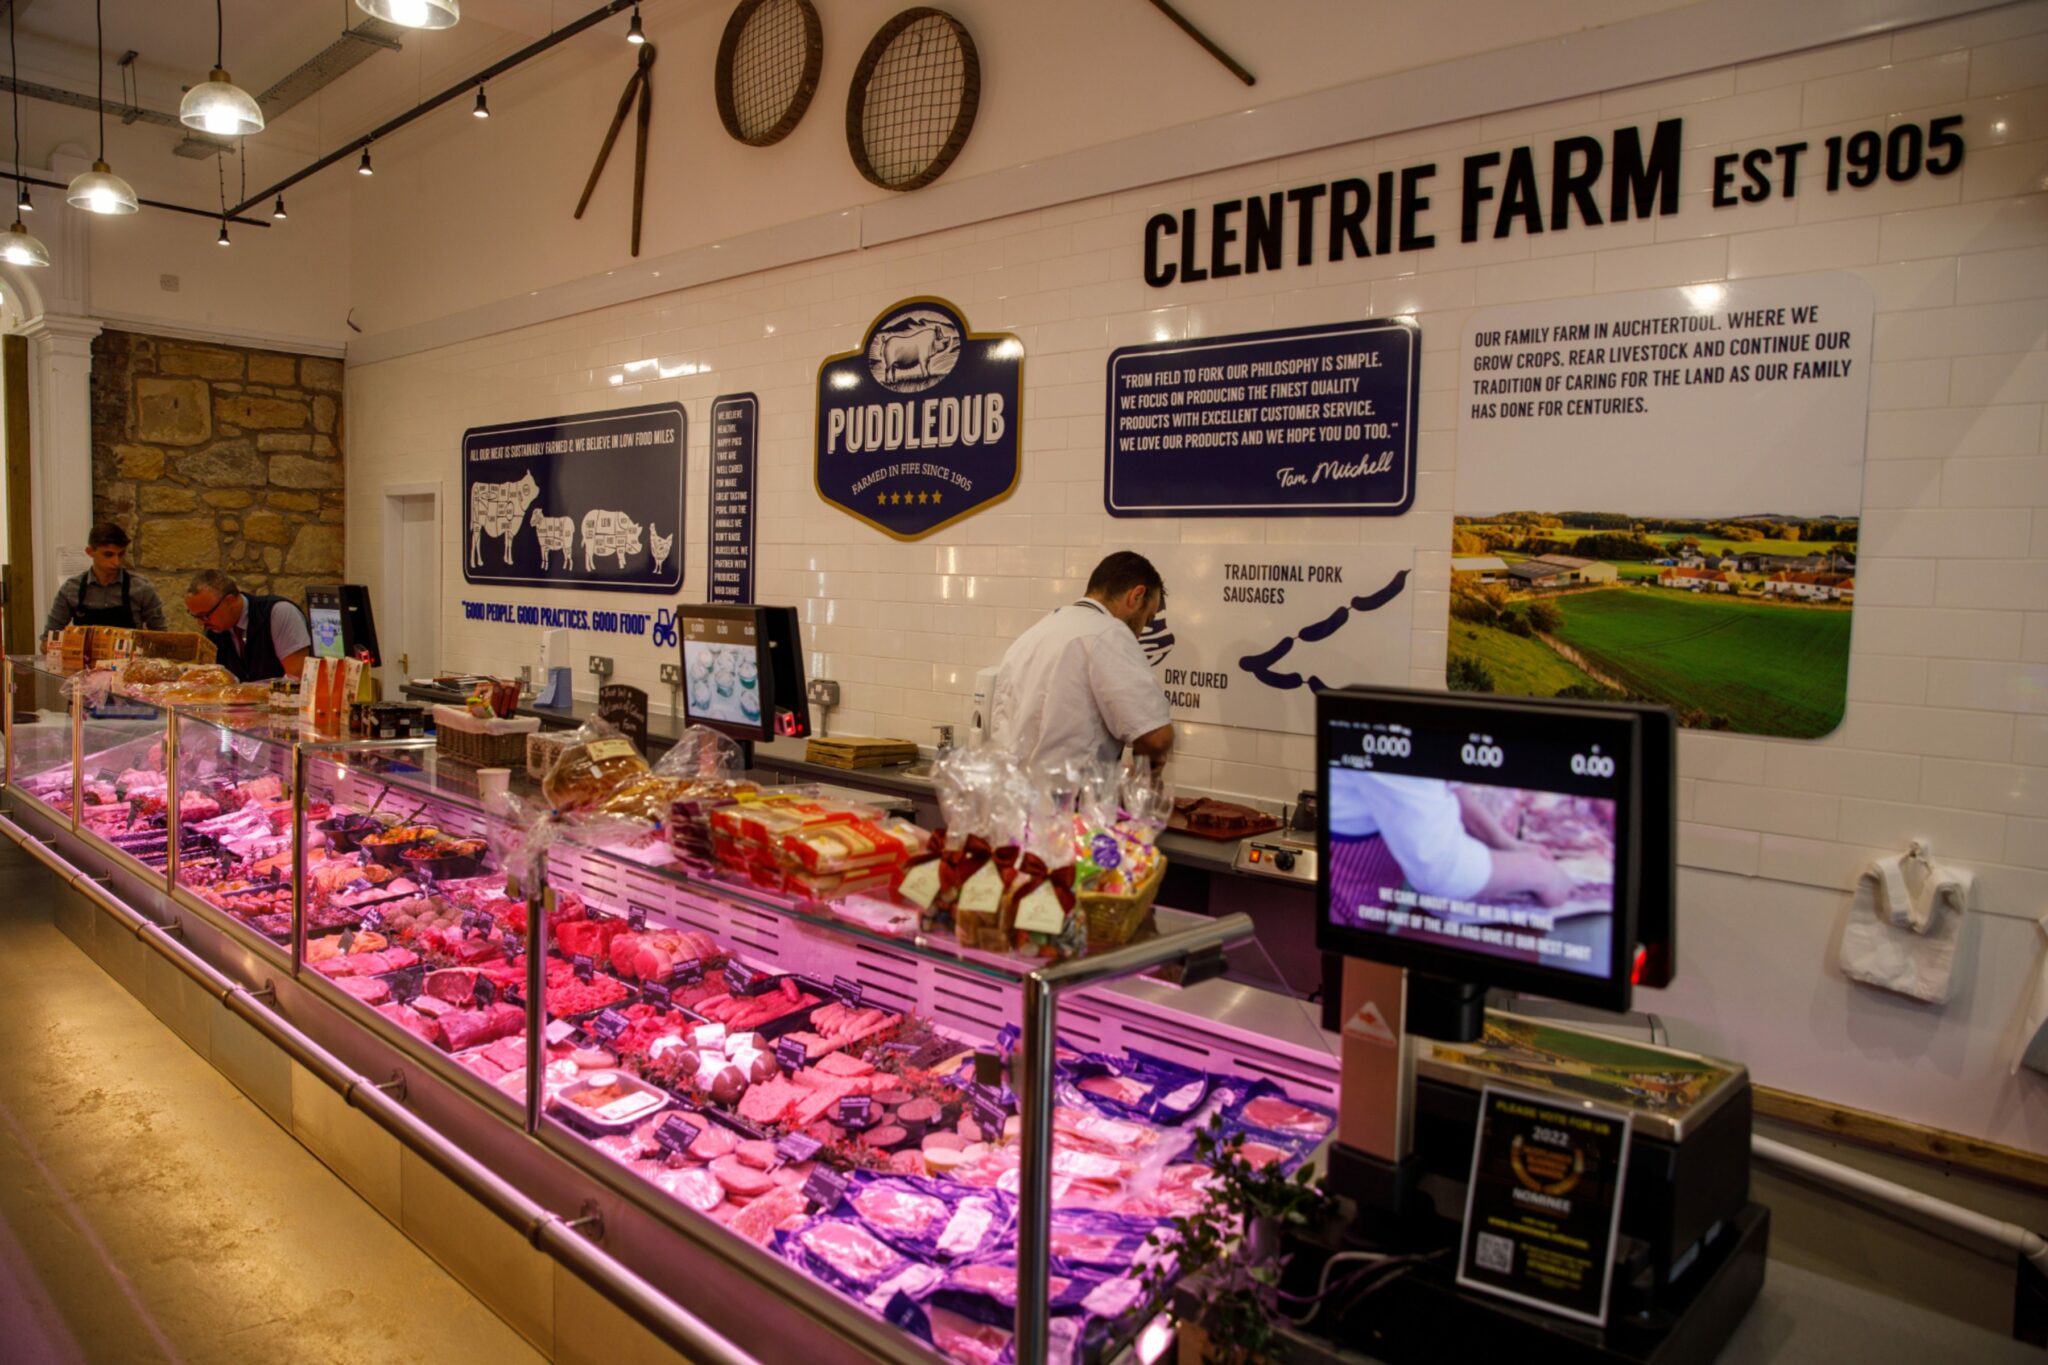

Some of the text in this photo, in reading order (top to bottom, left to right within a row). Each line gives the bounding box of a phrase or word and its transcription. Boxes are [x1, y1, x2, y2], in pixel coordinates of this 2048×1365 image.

[1144, 114, 1965, 288] CLENTRIE FARM EST 1905
[1475, 331, 1500, 348] OUR
[1504, 327, 1549, 345] FAMILY
[1553, 324, 1590, 342] FARM
[1594, 322, 1608, 339] IN
[1728, 308, 1786, 329] WHERE
[1791, 305, 1819, 324] WE
[1473, 331, 1851, 371] GROW CROPS. REAR LIVESTOCK AND CONTINUE OUR
[1154, 370, 1180, 386] FIELD
[1183, 369, 1196, 384] TO
[1198, 366, 1224, 382] FORK
[1227, 364, 1248, 379] OUR
[1250, 357, 1319, 378] PHILOSOPHY
[1322, 355, 1333, 372] IS
[1336, 352, 1382, 370] SIMPLE.
[1473, 359, 1852, 395] TRADITION OF CARING FOR THE LAND AS OUR FAMILY
[1121, 377, 1360, 410] WE FOCUS ON PRODUCING THE FINEST QUALITY
[1471, 397, 1648, 419] HAS DONE FOR CENTURIES.
[827, 392, 1006, 454] PUDDLEDUB
[1120, 400, 1375, 431] PRODUCTS WITH EXCELLENT CUSTOMER SERVICE.
[491, 446, 504, 460] MEAT
[505, 446, 511, 458] IS
[511, 442, 545, 458] SUSTAINABLY
[545, 439, 567, 455] FARMED
[575, 438, 585, 452] WE
[586, 435, 611, 451] BELIEVE
[612, 434, 618, 448] IN
[619, 433, 634, 448] LOW
[635, 431, 653, 446] FOOD
[653, 428, 675, 445] MILES
[1120, 437, 1135, 451] WE
[1137, 435, 1160, 450] LOVE
[1163, 434, 1182, 449] OUR
[1185, 432, 1238, 448] PRODUCTS
[1241, 430, 1263, 445] AND
[1266, 429, 1284, 444] WE
[1287, 427, 1316, 443] HOPE
[1319, 425, 1342, 442] YOU
[1344, 424, 1360, 441] DO
[851, 463, 973, 495] FARMED IN FIFE SINCE 1905
[1312, 451, 1394, 484] Mitchell
[1224, 564, 1343, 583] TRADITIONAL PORK
[1223, 586, 1285, 604] SAUSAGES
[486, 603, 516, 624] PEOPLE.
[517, 605, 539, 625] GOOD
[540, 607, 591, 630] PRACTICES.
[592, 611, 618, 632] GOOD
[1164, 669, 1228, 690] DRY CURED
[1362, 733, 1615, 778] 0.000 0.00 0.00
[1496, 1100, 1537, 1119] PLEASE
[1532, 1126, 1569, 1146] 2022
[1512, 1187, 1571, 1213] NOMINEE
